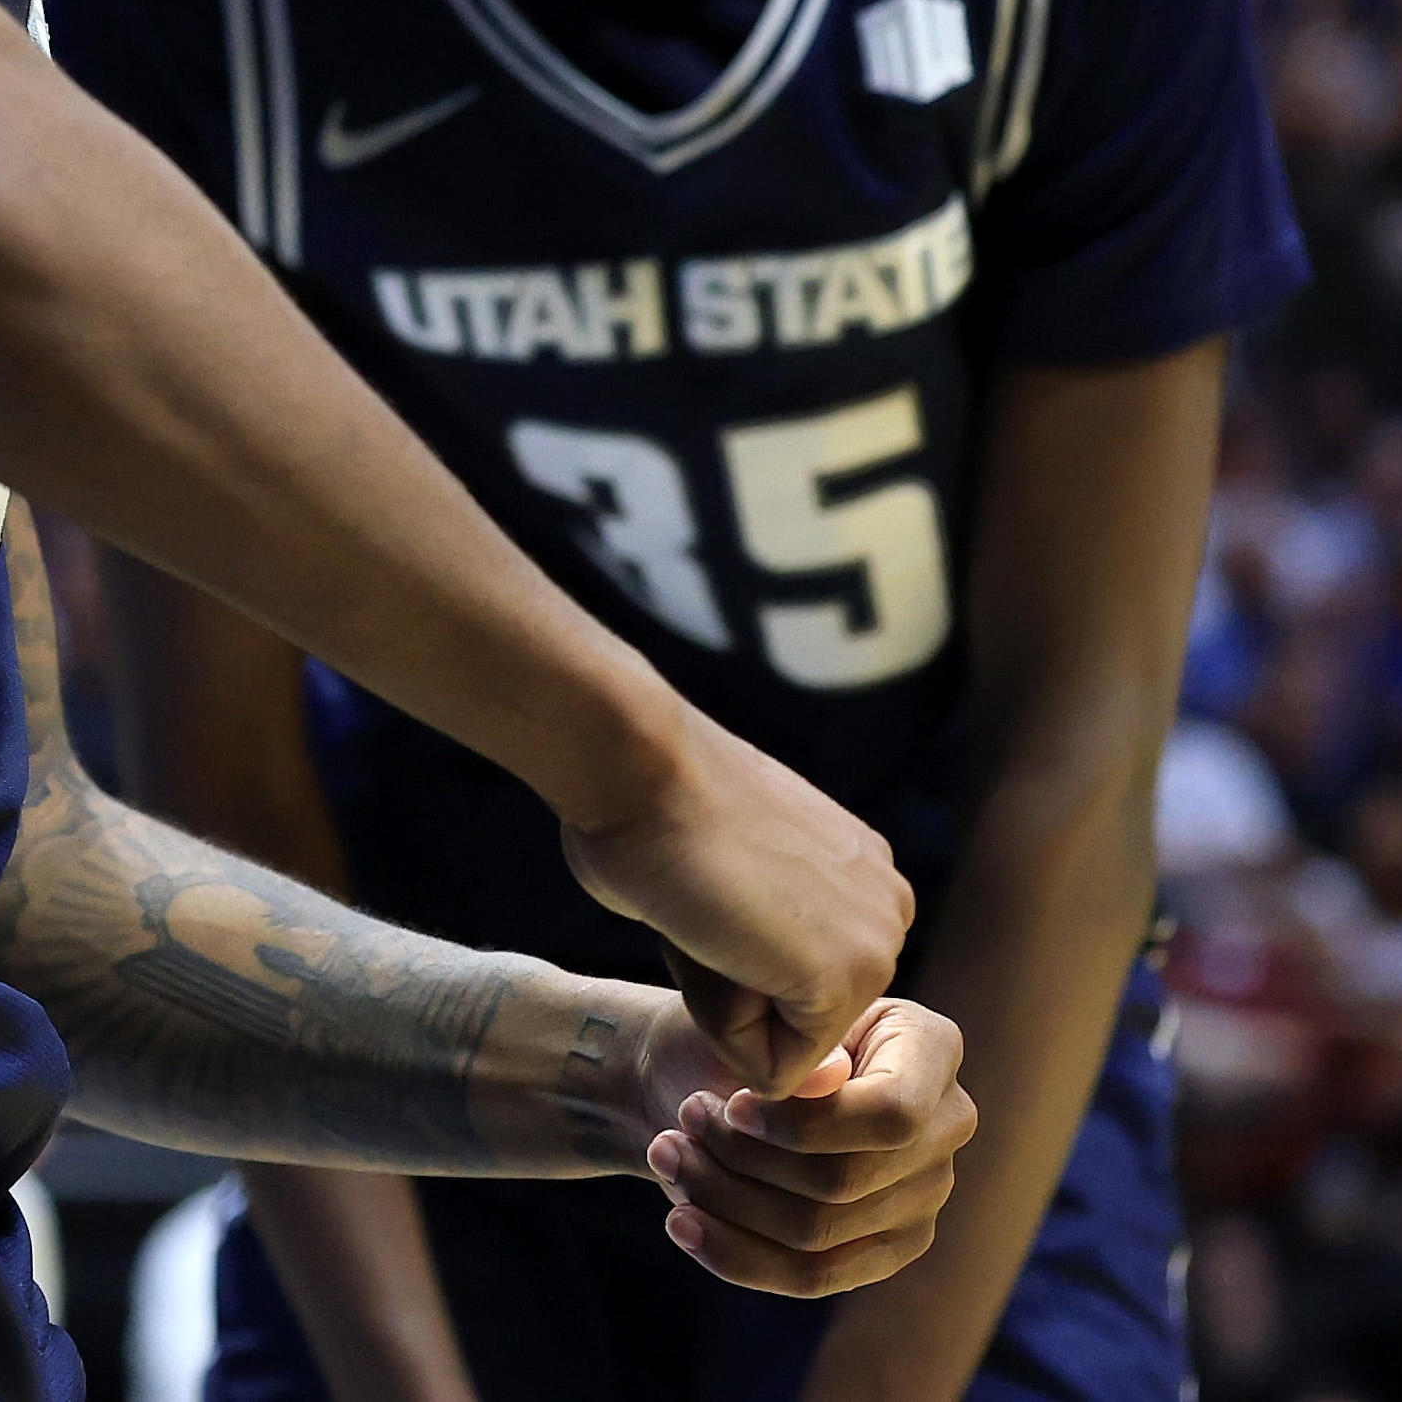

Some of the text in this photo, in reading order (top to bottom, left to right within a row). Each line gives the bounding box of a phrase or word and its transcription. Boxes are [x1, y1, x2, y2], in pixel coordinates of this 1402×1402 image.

[372, 192, 974, 363] UTAH STATE
[506, 384, 952, 690] 35
